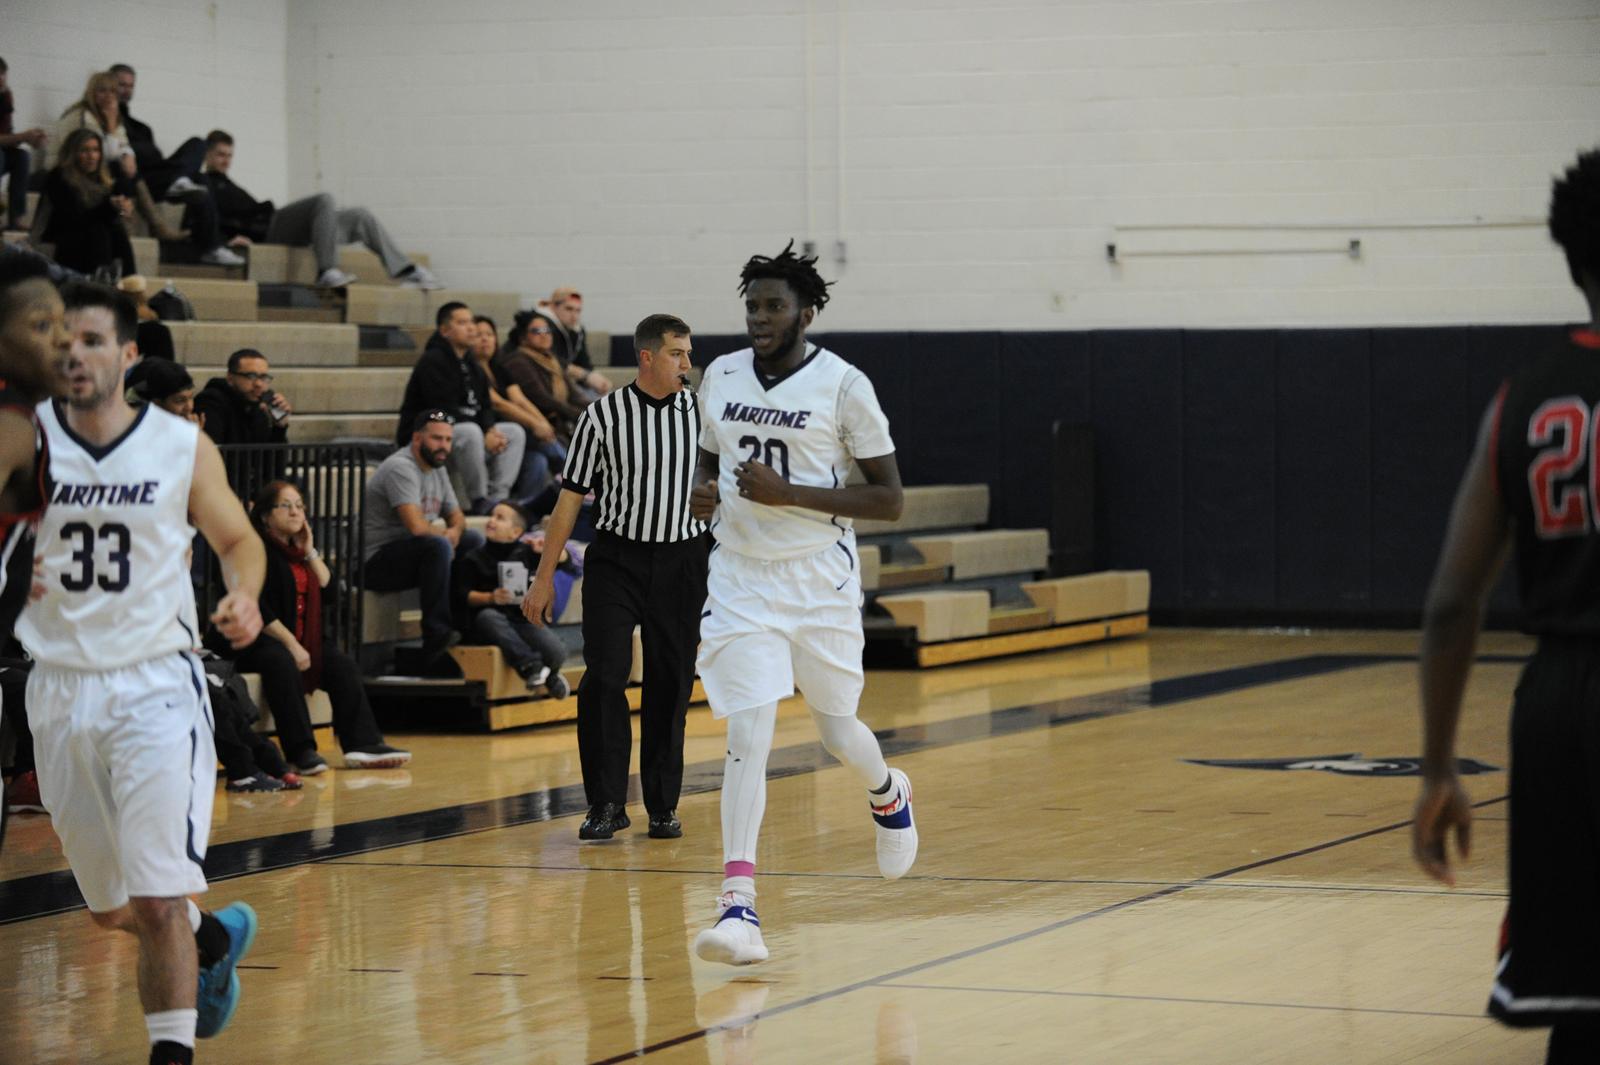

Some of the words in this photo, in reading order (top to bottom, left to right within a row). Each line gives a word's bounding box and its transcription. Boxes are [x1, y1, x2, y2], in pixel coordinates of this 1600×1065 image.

[721, 402, 811, 430] MARITIME
[1528, 397, 1600, 538] 2
[60, 521, 131, 592] 33
